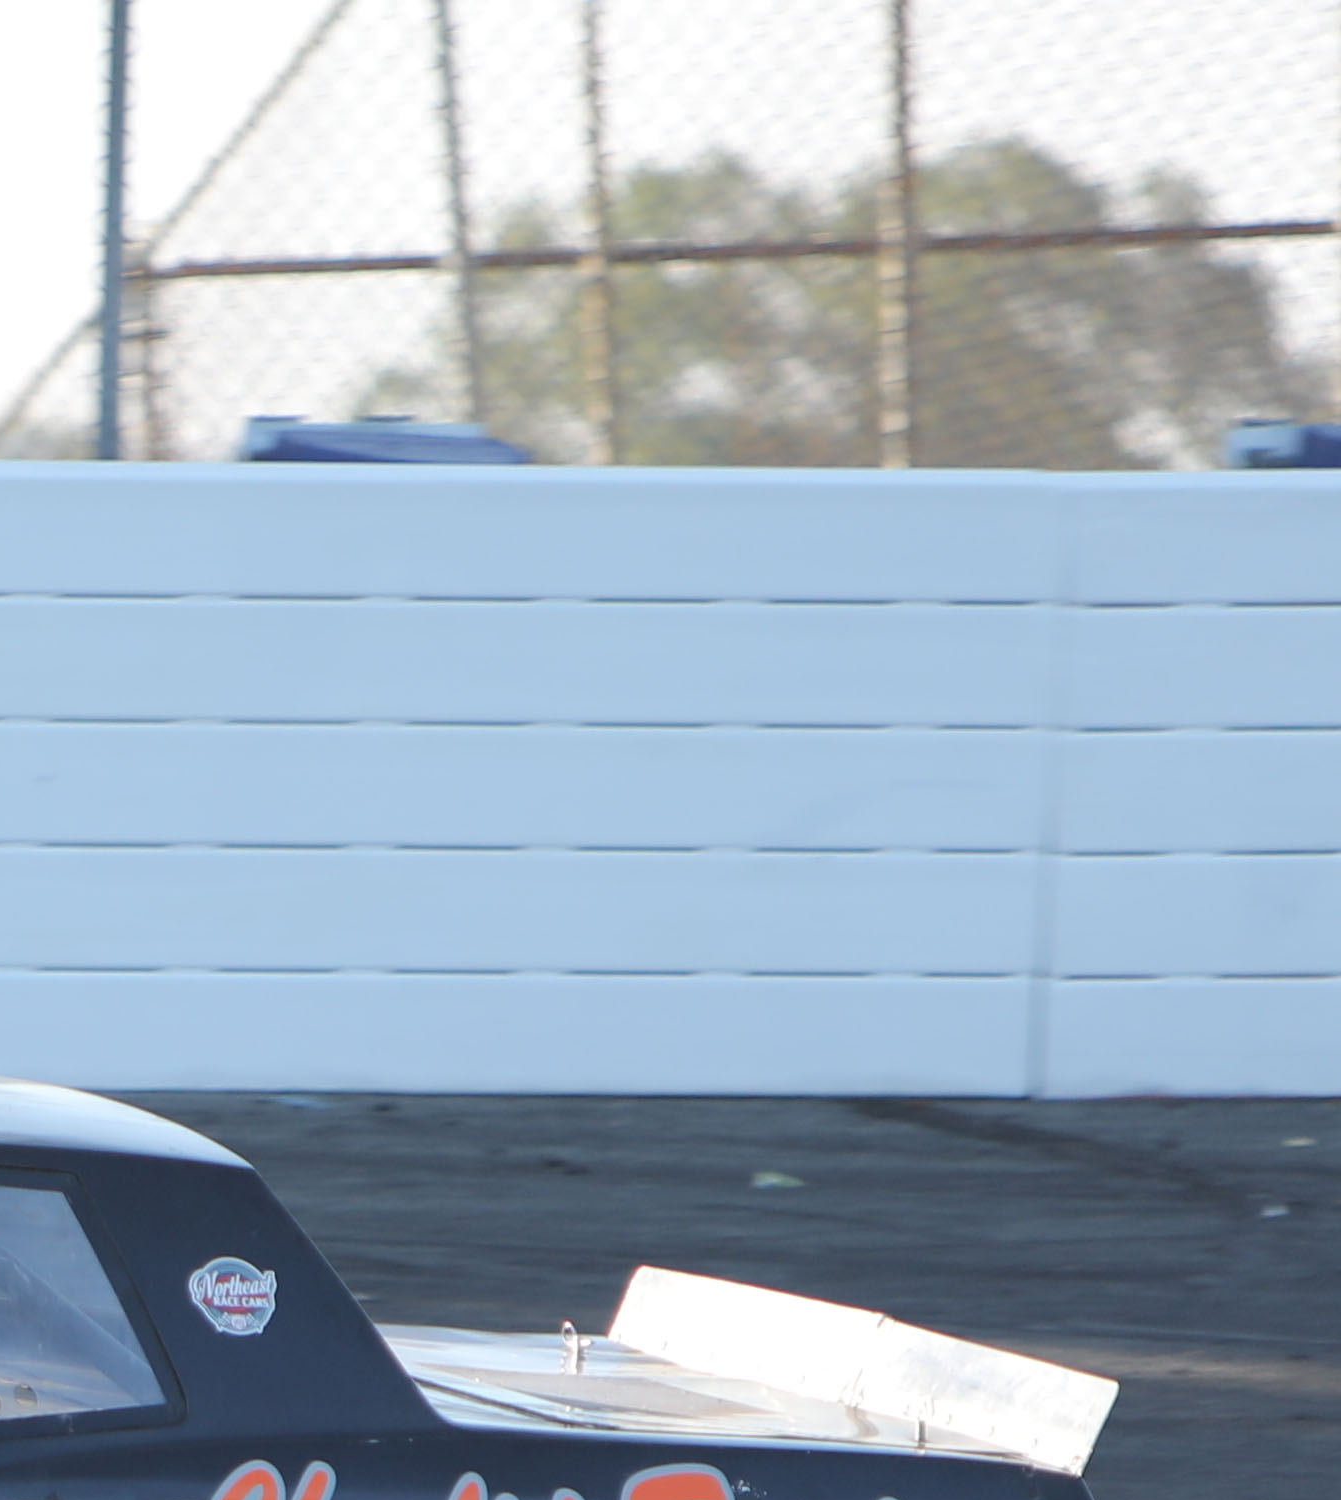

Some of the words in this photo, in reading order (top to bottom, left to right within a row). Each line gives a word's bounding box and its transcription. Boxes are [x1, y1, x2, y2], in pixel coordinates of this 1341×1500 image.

[193, 1270, 272, 1299] Northeast
[214, 1296, 239, 1306] RACE
[243, 1297, 269, 1308] CARS
